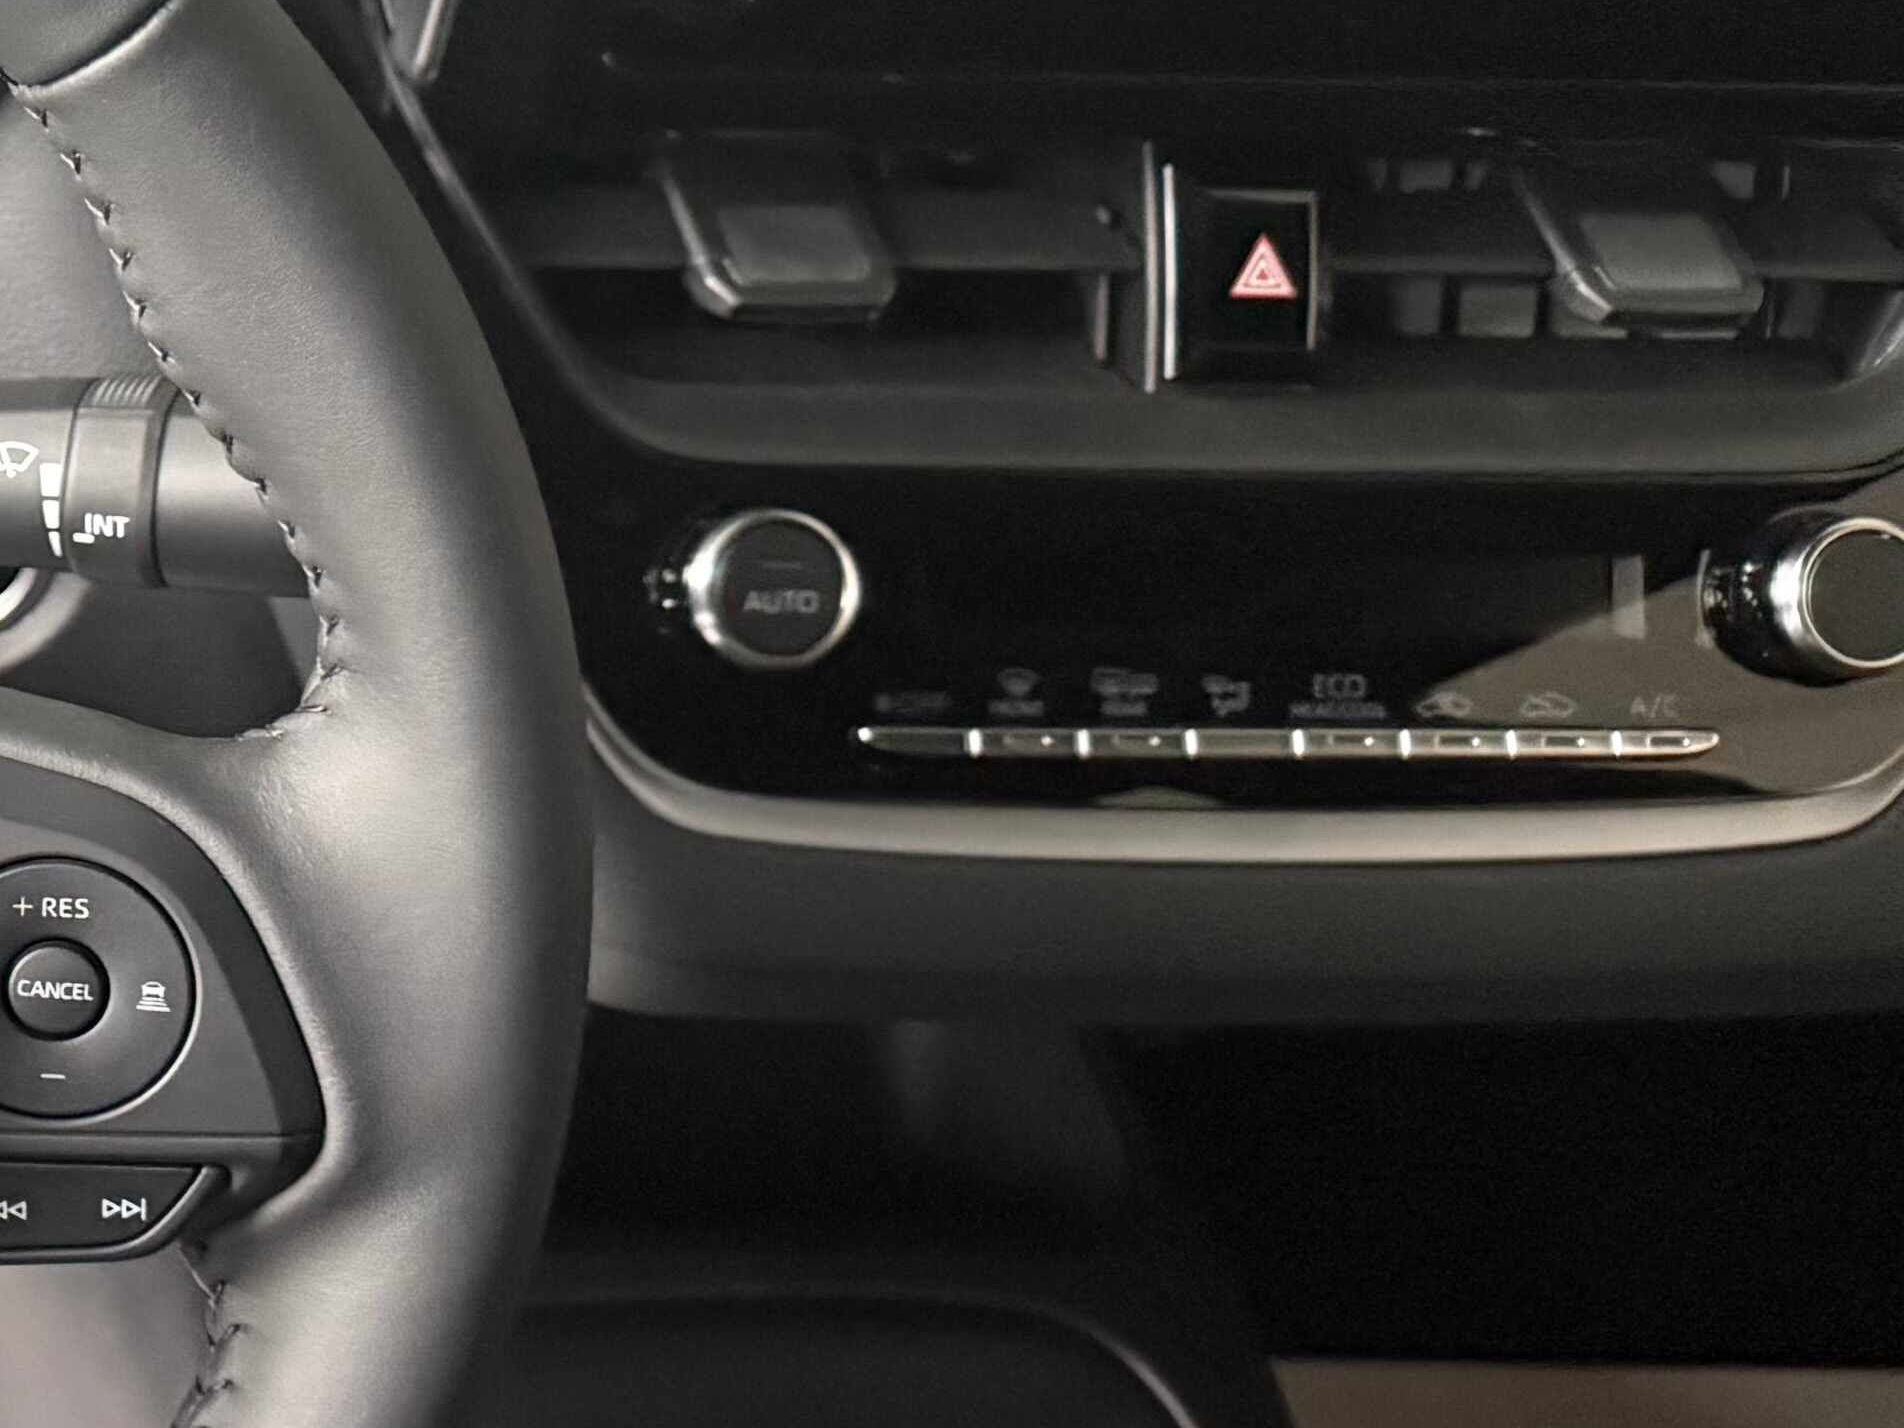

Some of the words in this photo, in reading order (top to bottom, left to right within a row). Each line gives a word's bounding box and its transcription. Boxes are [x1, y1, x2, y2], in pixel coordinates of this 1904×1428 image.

[84, 512, 131, 539] INT
[742, 588, 821, 614] AUTO
[41, 896, 91, 920] RES
[16, 978, 95, 1002] CANCEL
